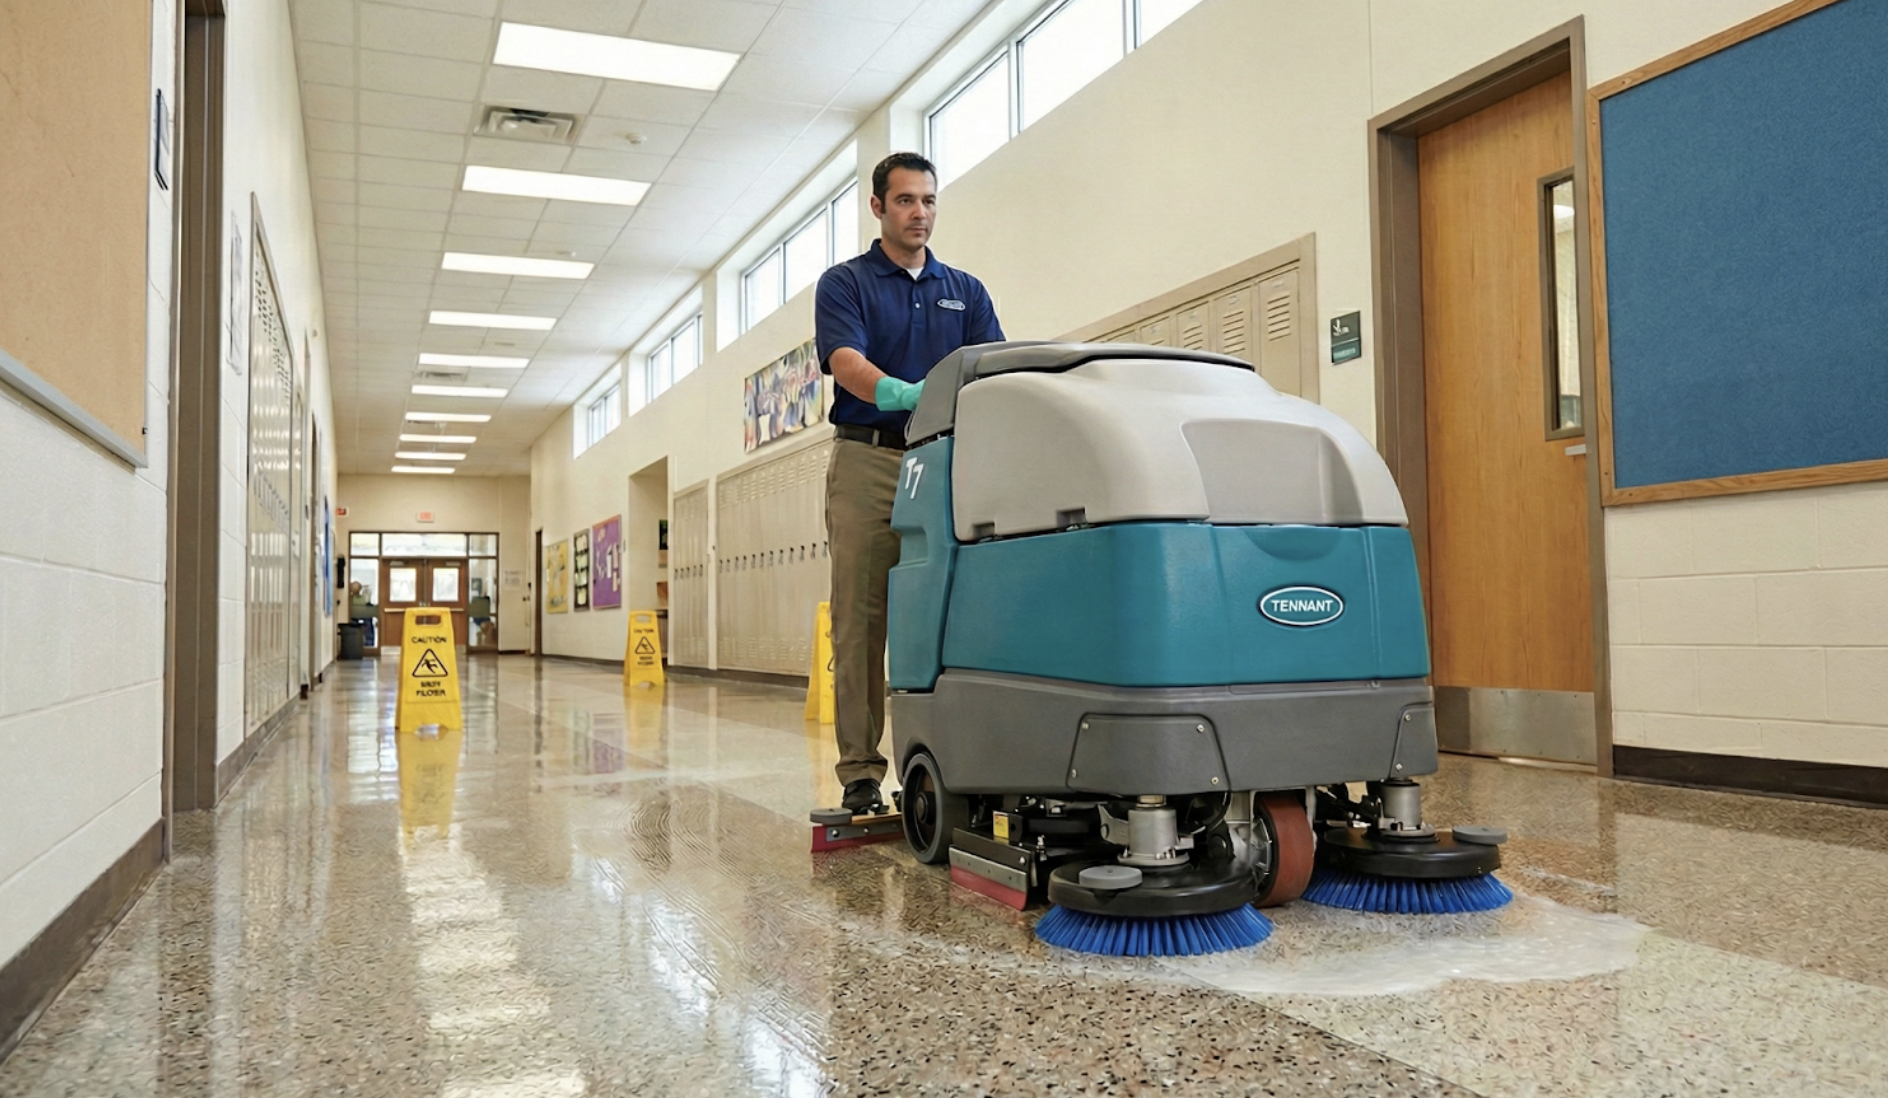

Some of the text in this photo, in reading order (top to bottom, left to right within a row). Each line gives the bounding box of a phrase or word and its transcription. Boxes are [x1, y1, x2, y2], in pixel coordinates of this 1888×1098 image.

[904, 456, 924, 500] T7
[1270, 599, 1334, 612] TENNANT
[411, 636, 447, 644] CAUTION
